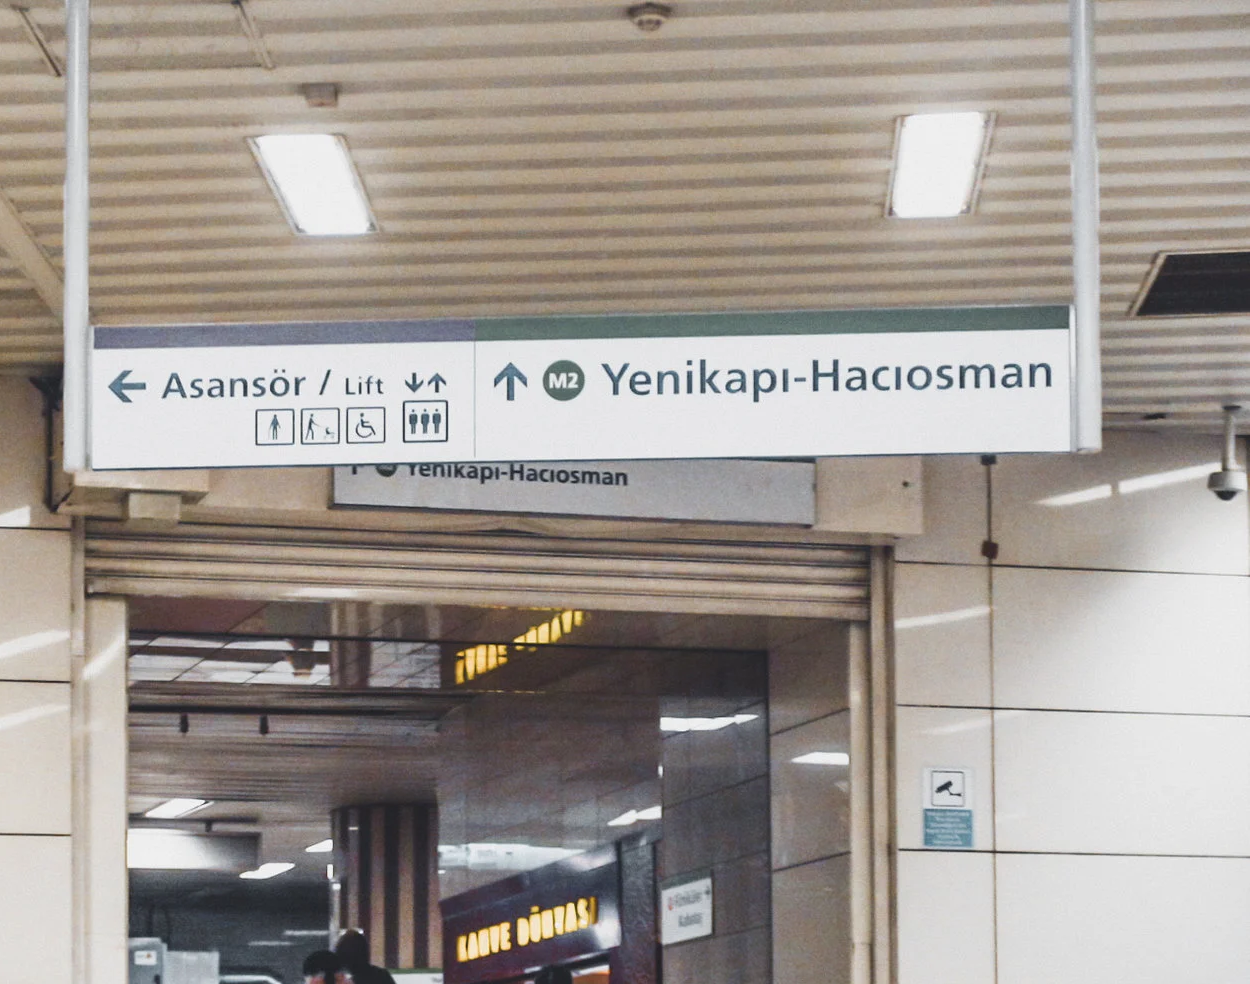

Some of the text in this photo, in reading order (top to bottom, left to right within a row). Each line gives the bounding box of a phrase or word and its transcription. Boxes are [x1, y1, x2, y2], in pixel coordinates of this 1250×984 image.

[161, 368, 385, 399] Asansör / Lift
[548, 359, 1053, 403] M2 Yenikapı-Hacıosman
